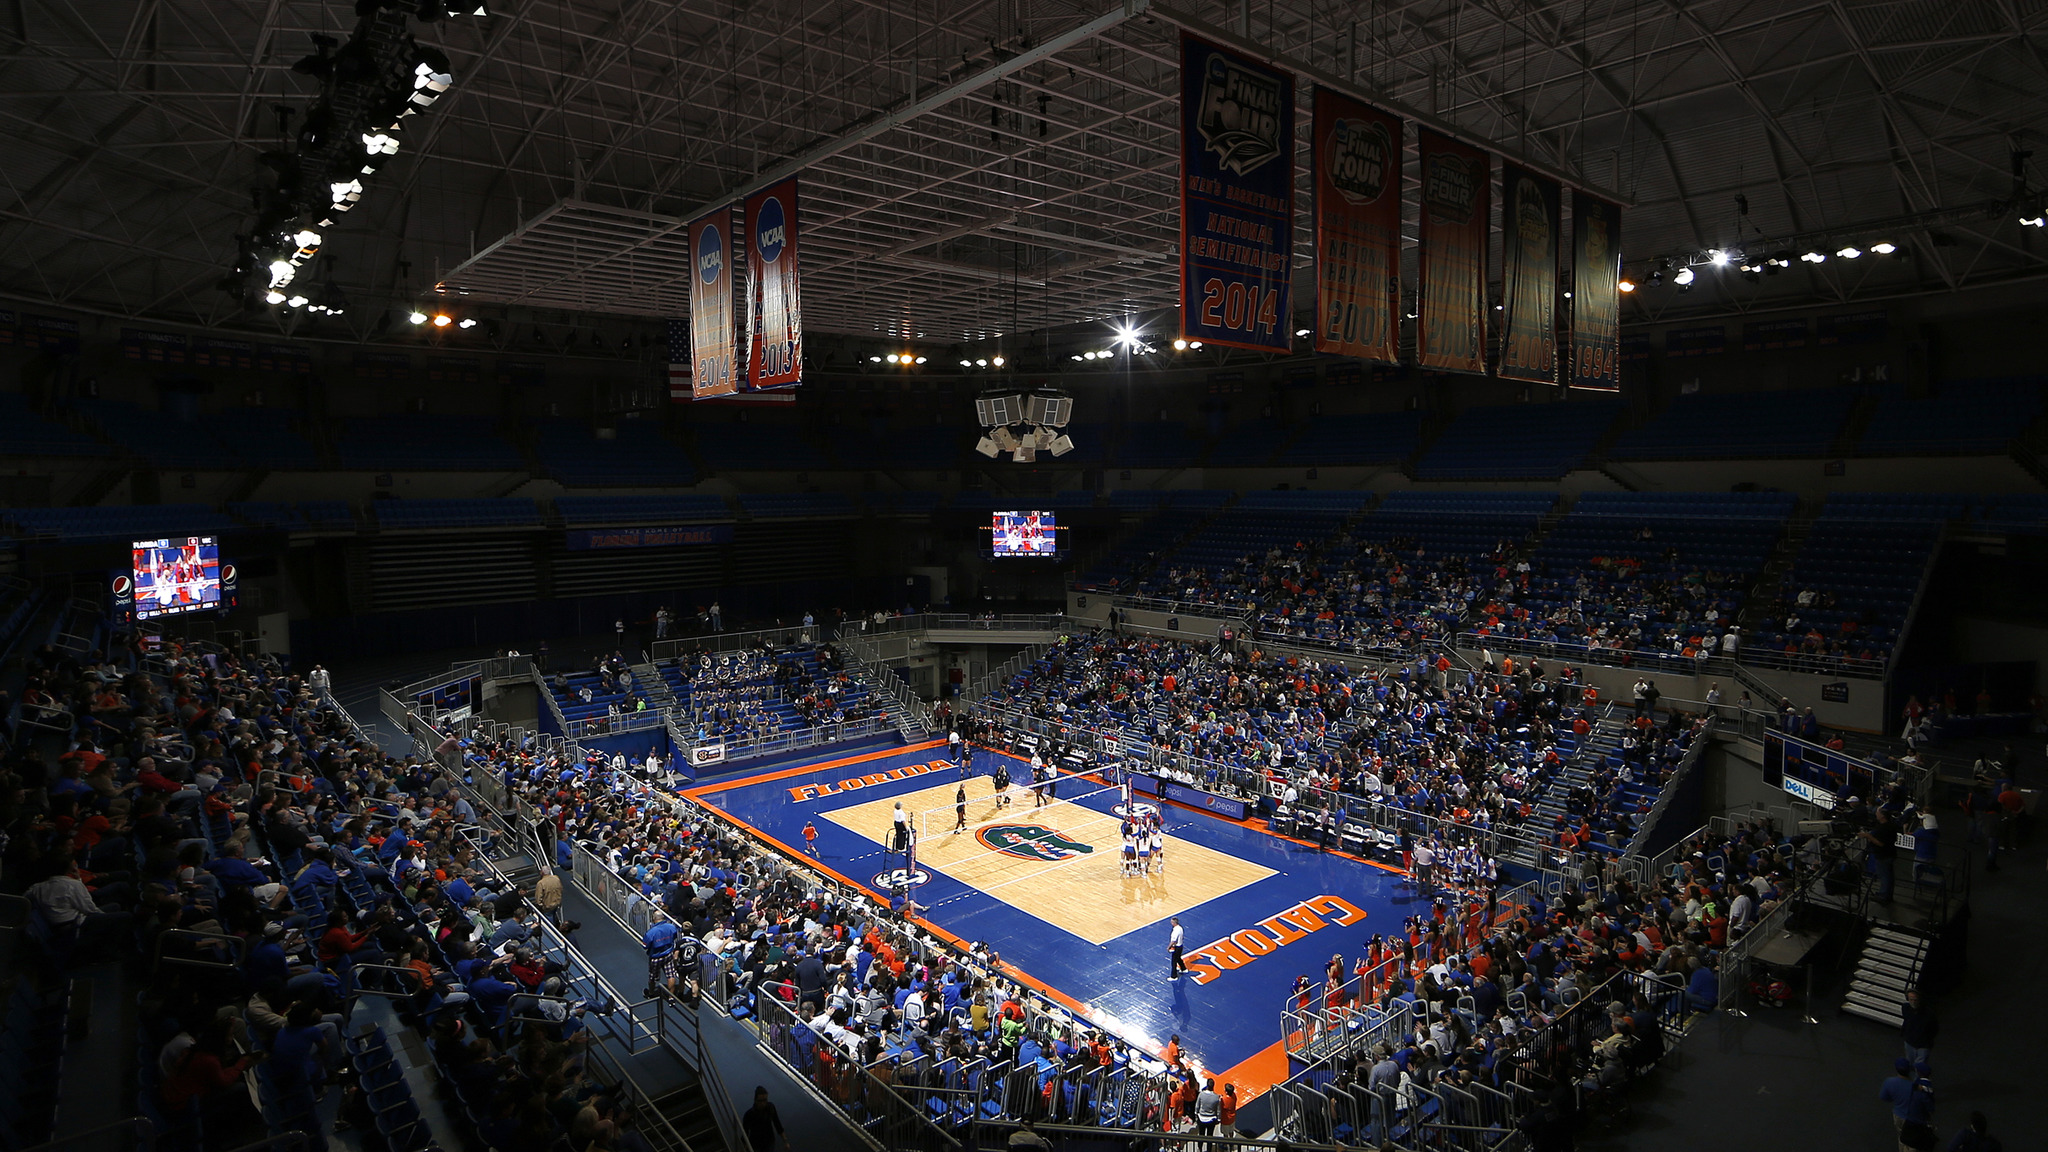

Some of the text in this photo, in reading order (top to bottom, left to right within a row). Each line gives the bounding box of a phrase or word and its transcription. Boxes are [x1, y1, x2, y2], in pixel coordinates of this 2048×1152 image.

[1225, 69, 1278, 114] FINAL
[1203, 82, 1277, 142] FOUR
[1347, 129, 1382, 163] FINAL
[1333, 141, 1382, 189] FOUR
[1429, 176, 1471, 207] FOUR
[761, 225, 786, 247] NCAA
[1206, 211, 1274, 245] NATIONAL
[700, 250, 723, 270] NCAA
[1189, 234, 1289, 272] SEMIFINALIST
[1201, 277, 1278, 335] 2014
[1326, 300, 1388, 347] 2007
[137, 331, 186, 344] GYMNASTICS
[699, 353, 730, 390] 2014
[758, 340, 794, 380] 2013
[1575, 345, 1614, 381] 1994
[1875, 365, 1887, 381] K
[590, 531, 712, 548] FLORIDA VOLLEYBALL
[786, 758, 960, 804] FLORIDA
[1785, 780, 1809, 797] DELL
[1215, 801, 1237, 813] pepsi
[1177, 895, 1367, 985] GATORS
